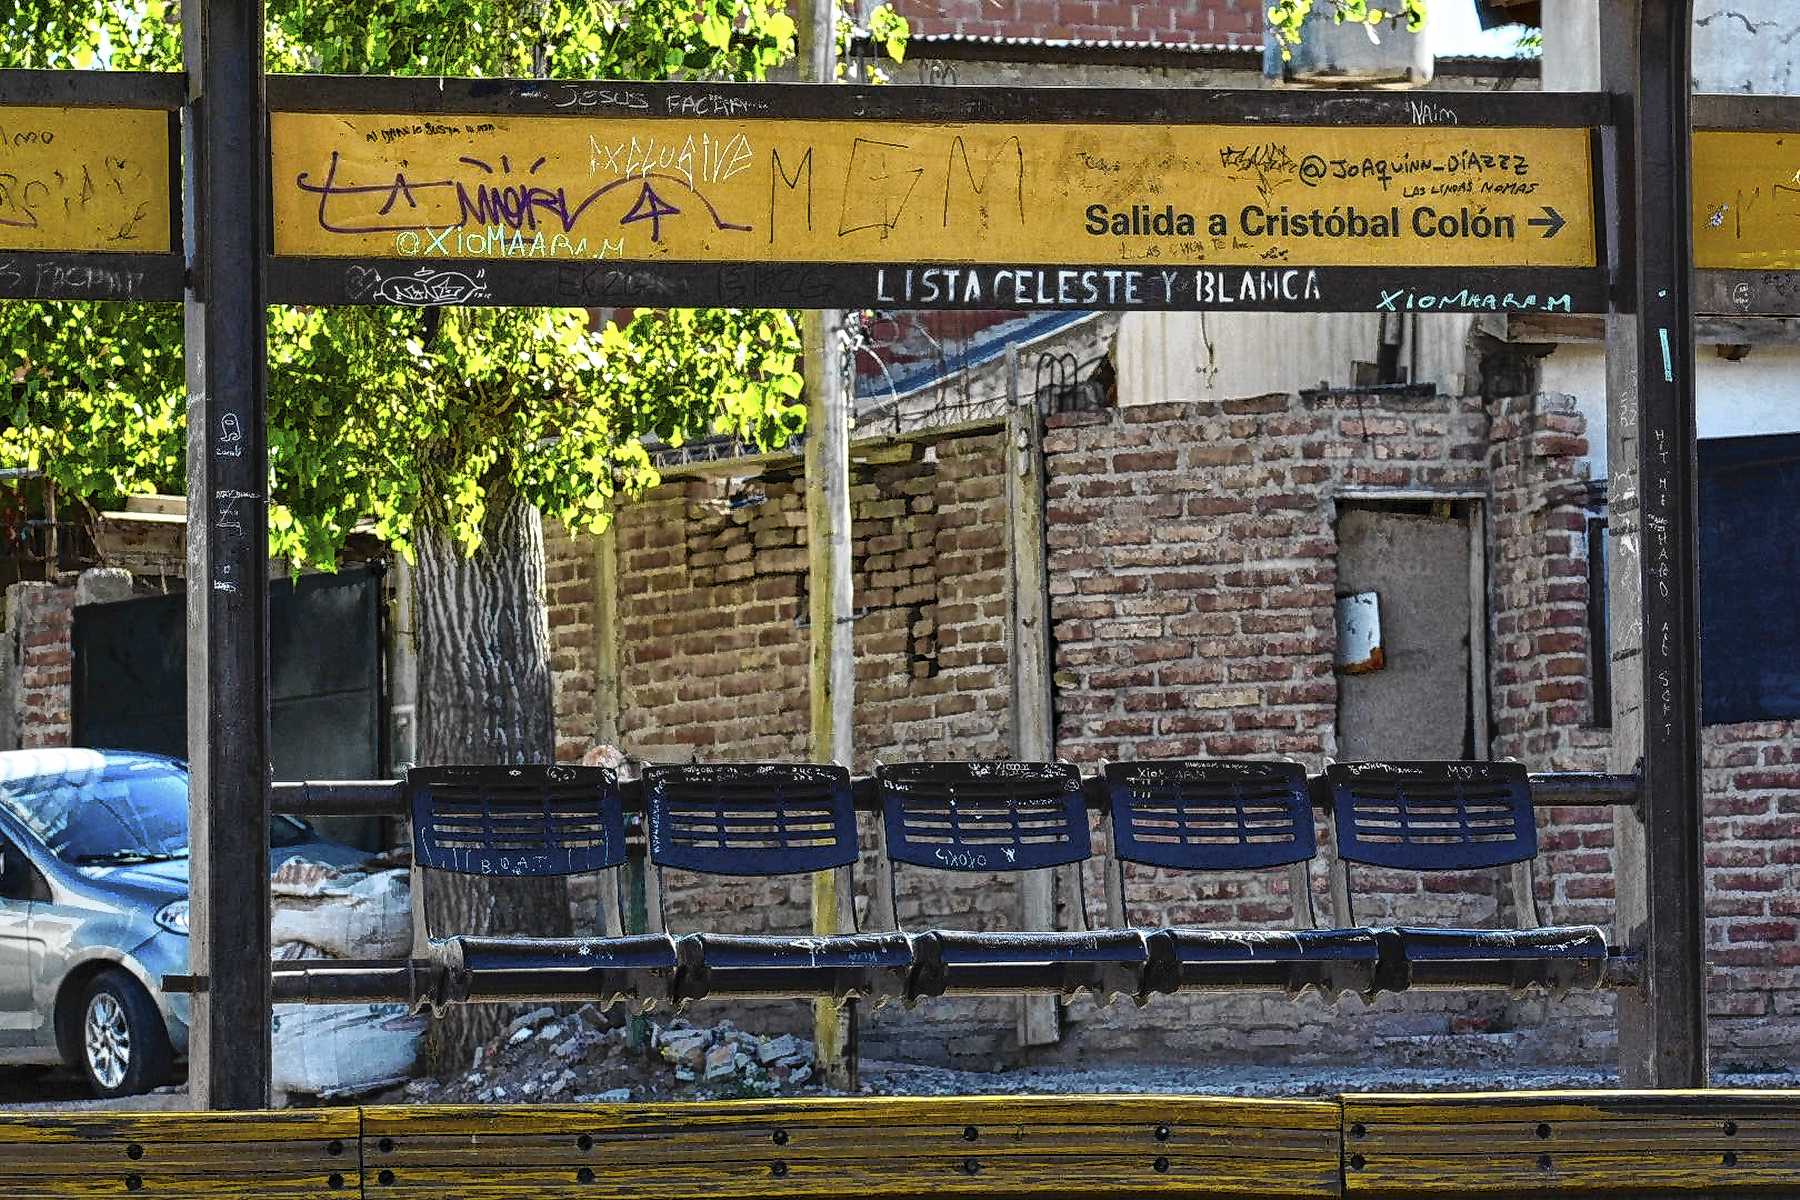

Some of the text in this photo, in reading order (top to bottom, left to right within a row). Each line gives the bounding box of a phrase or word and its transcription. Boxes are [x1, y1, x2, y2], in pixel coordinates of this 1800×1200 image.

[1085, 204, 1515, 239] Salida a Cristóbal Colón
[876, 269, 981, 303] LISTA
[993, 269, 1143, 304] CELESTE
[1162, 269, 1178, 303] Y
